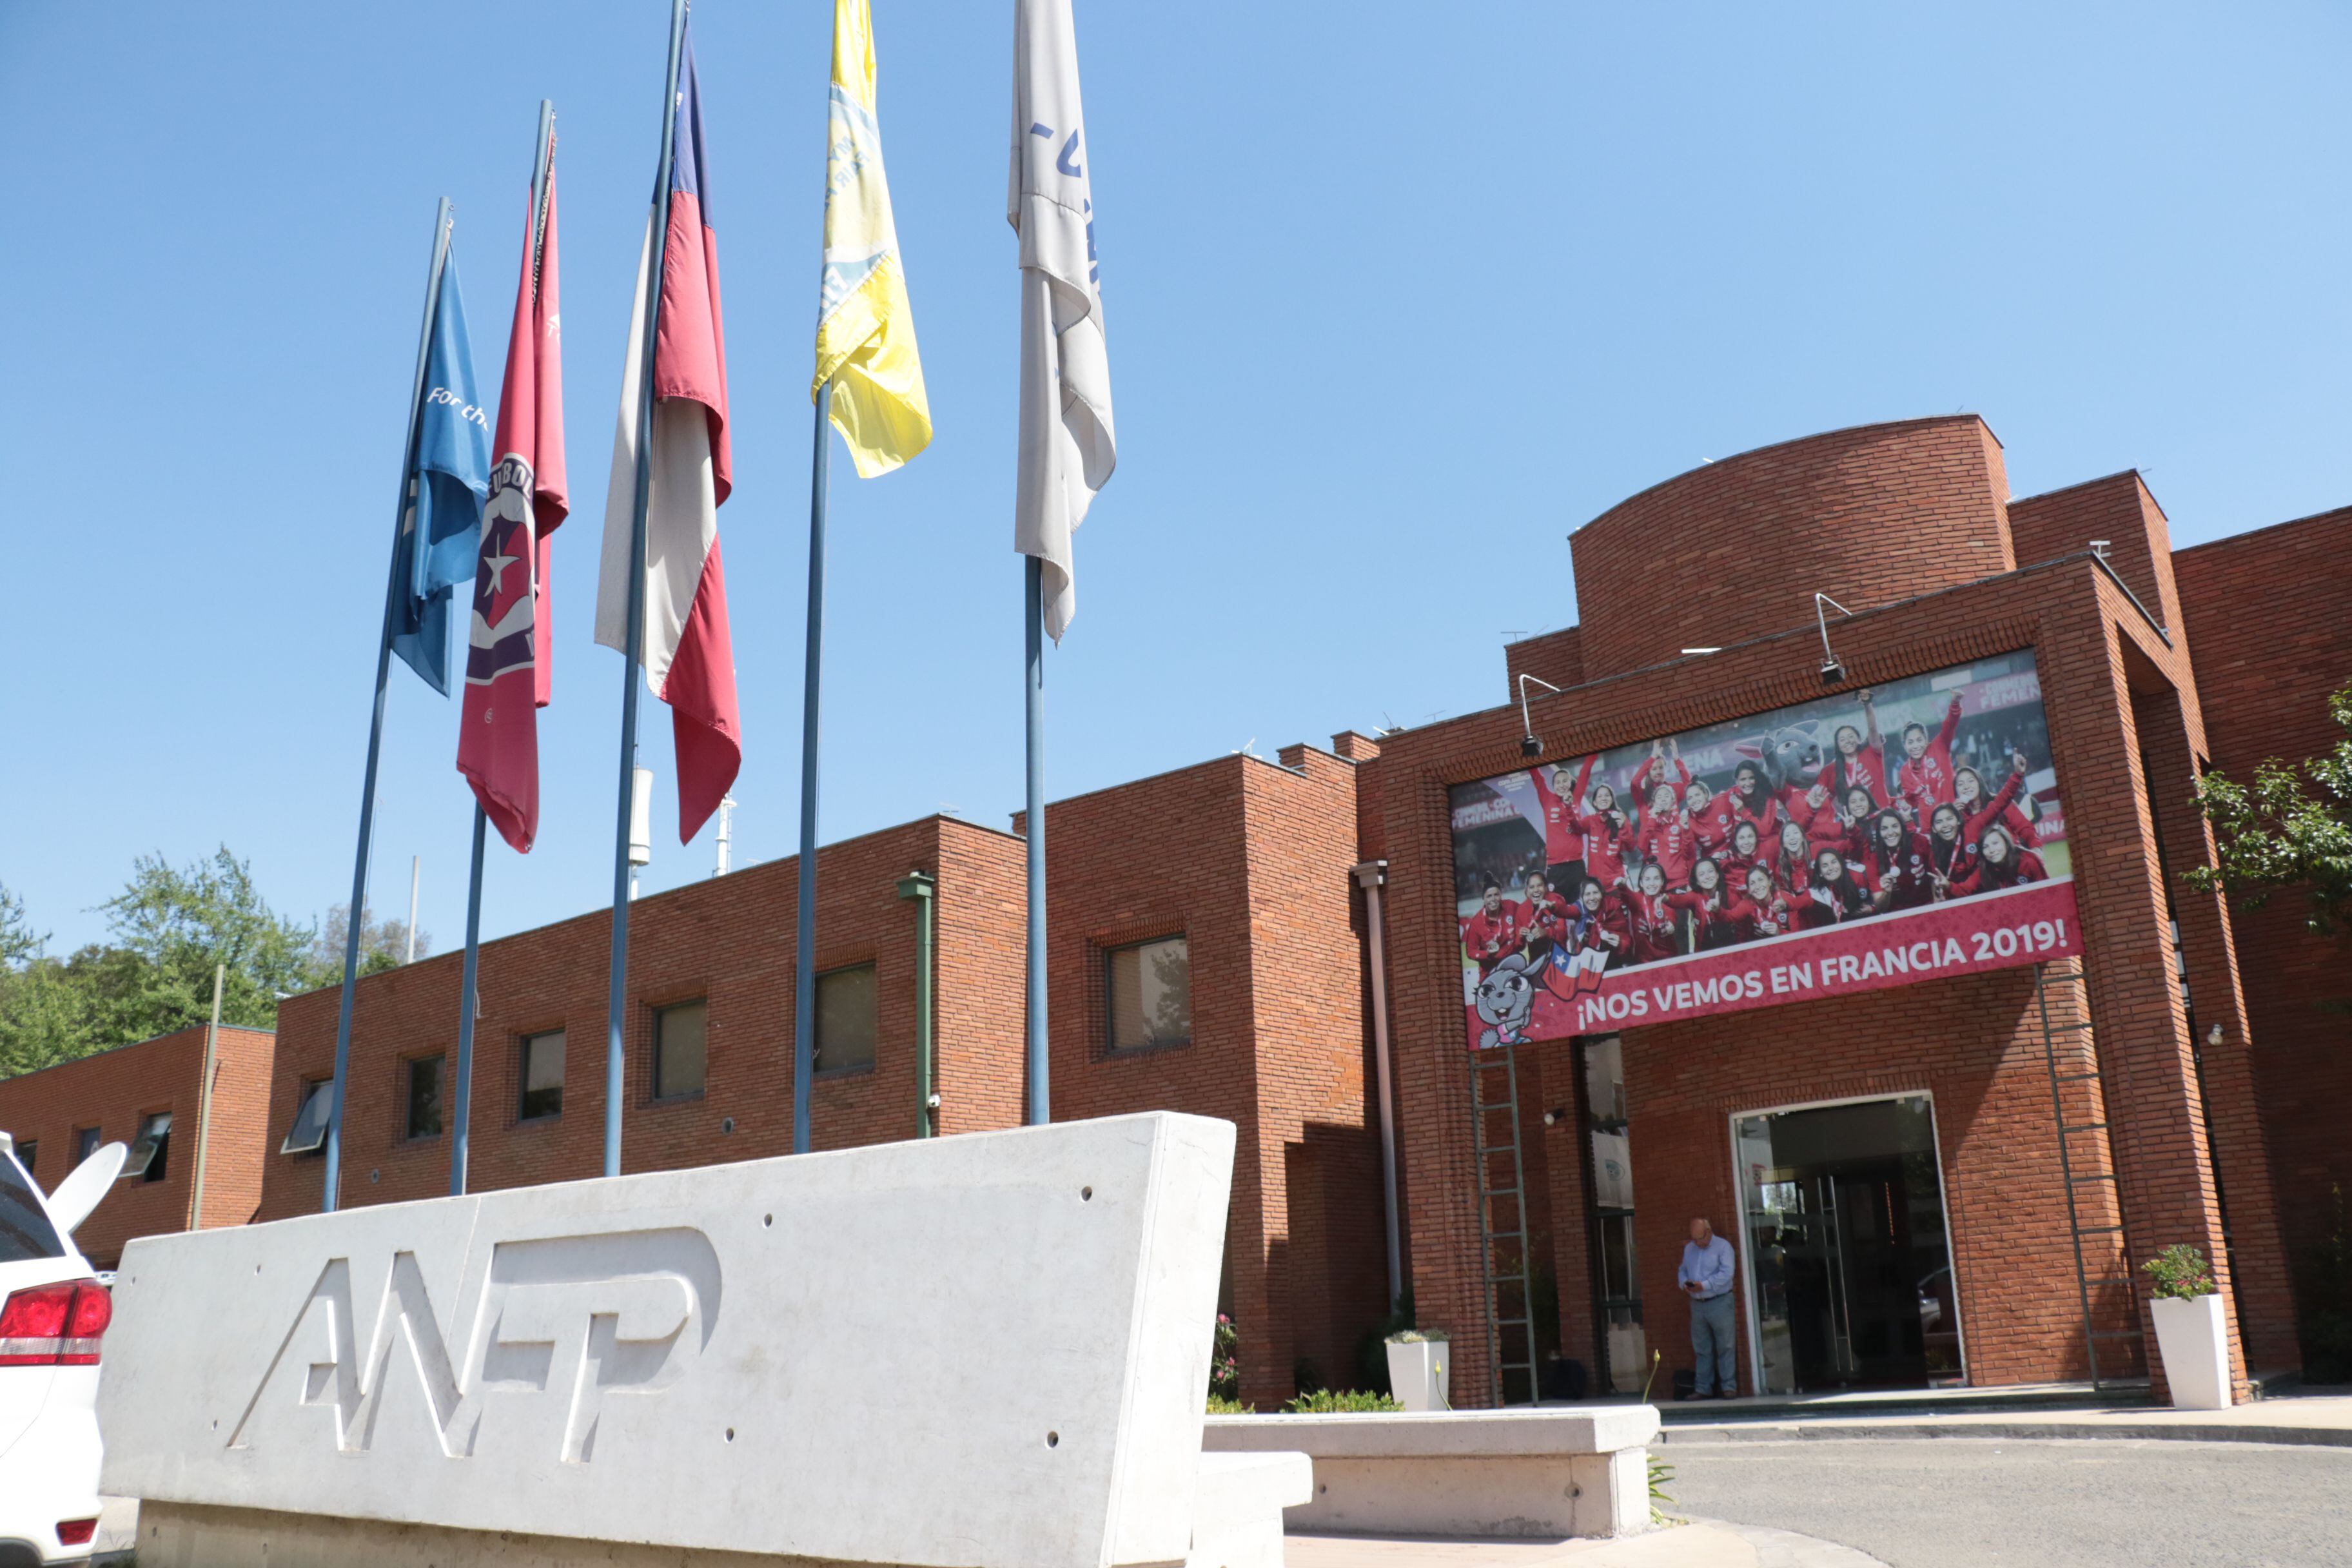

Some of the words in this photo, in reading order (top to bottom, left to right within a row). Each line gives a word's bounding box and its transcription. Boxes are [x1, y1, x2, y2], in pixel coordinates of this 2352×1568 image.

[427, 387, 462, 406] For
[1577, 990, 1649, 1030] ¡NOS
[1652, 971, 1764, 1012] VEMOS
[1770, 962, 1814, 994] EN
[1820, 937, 1967, 986] FRANCIA
[1970, 918, 2068, 961] 2019!
[227, 1226, 722, 1464] ANFP
